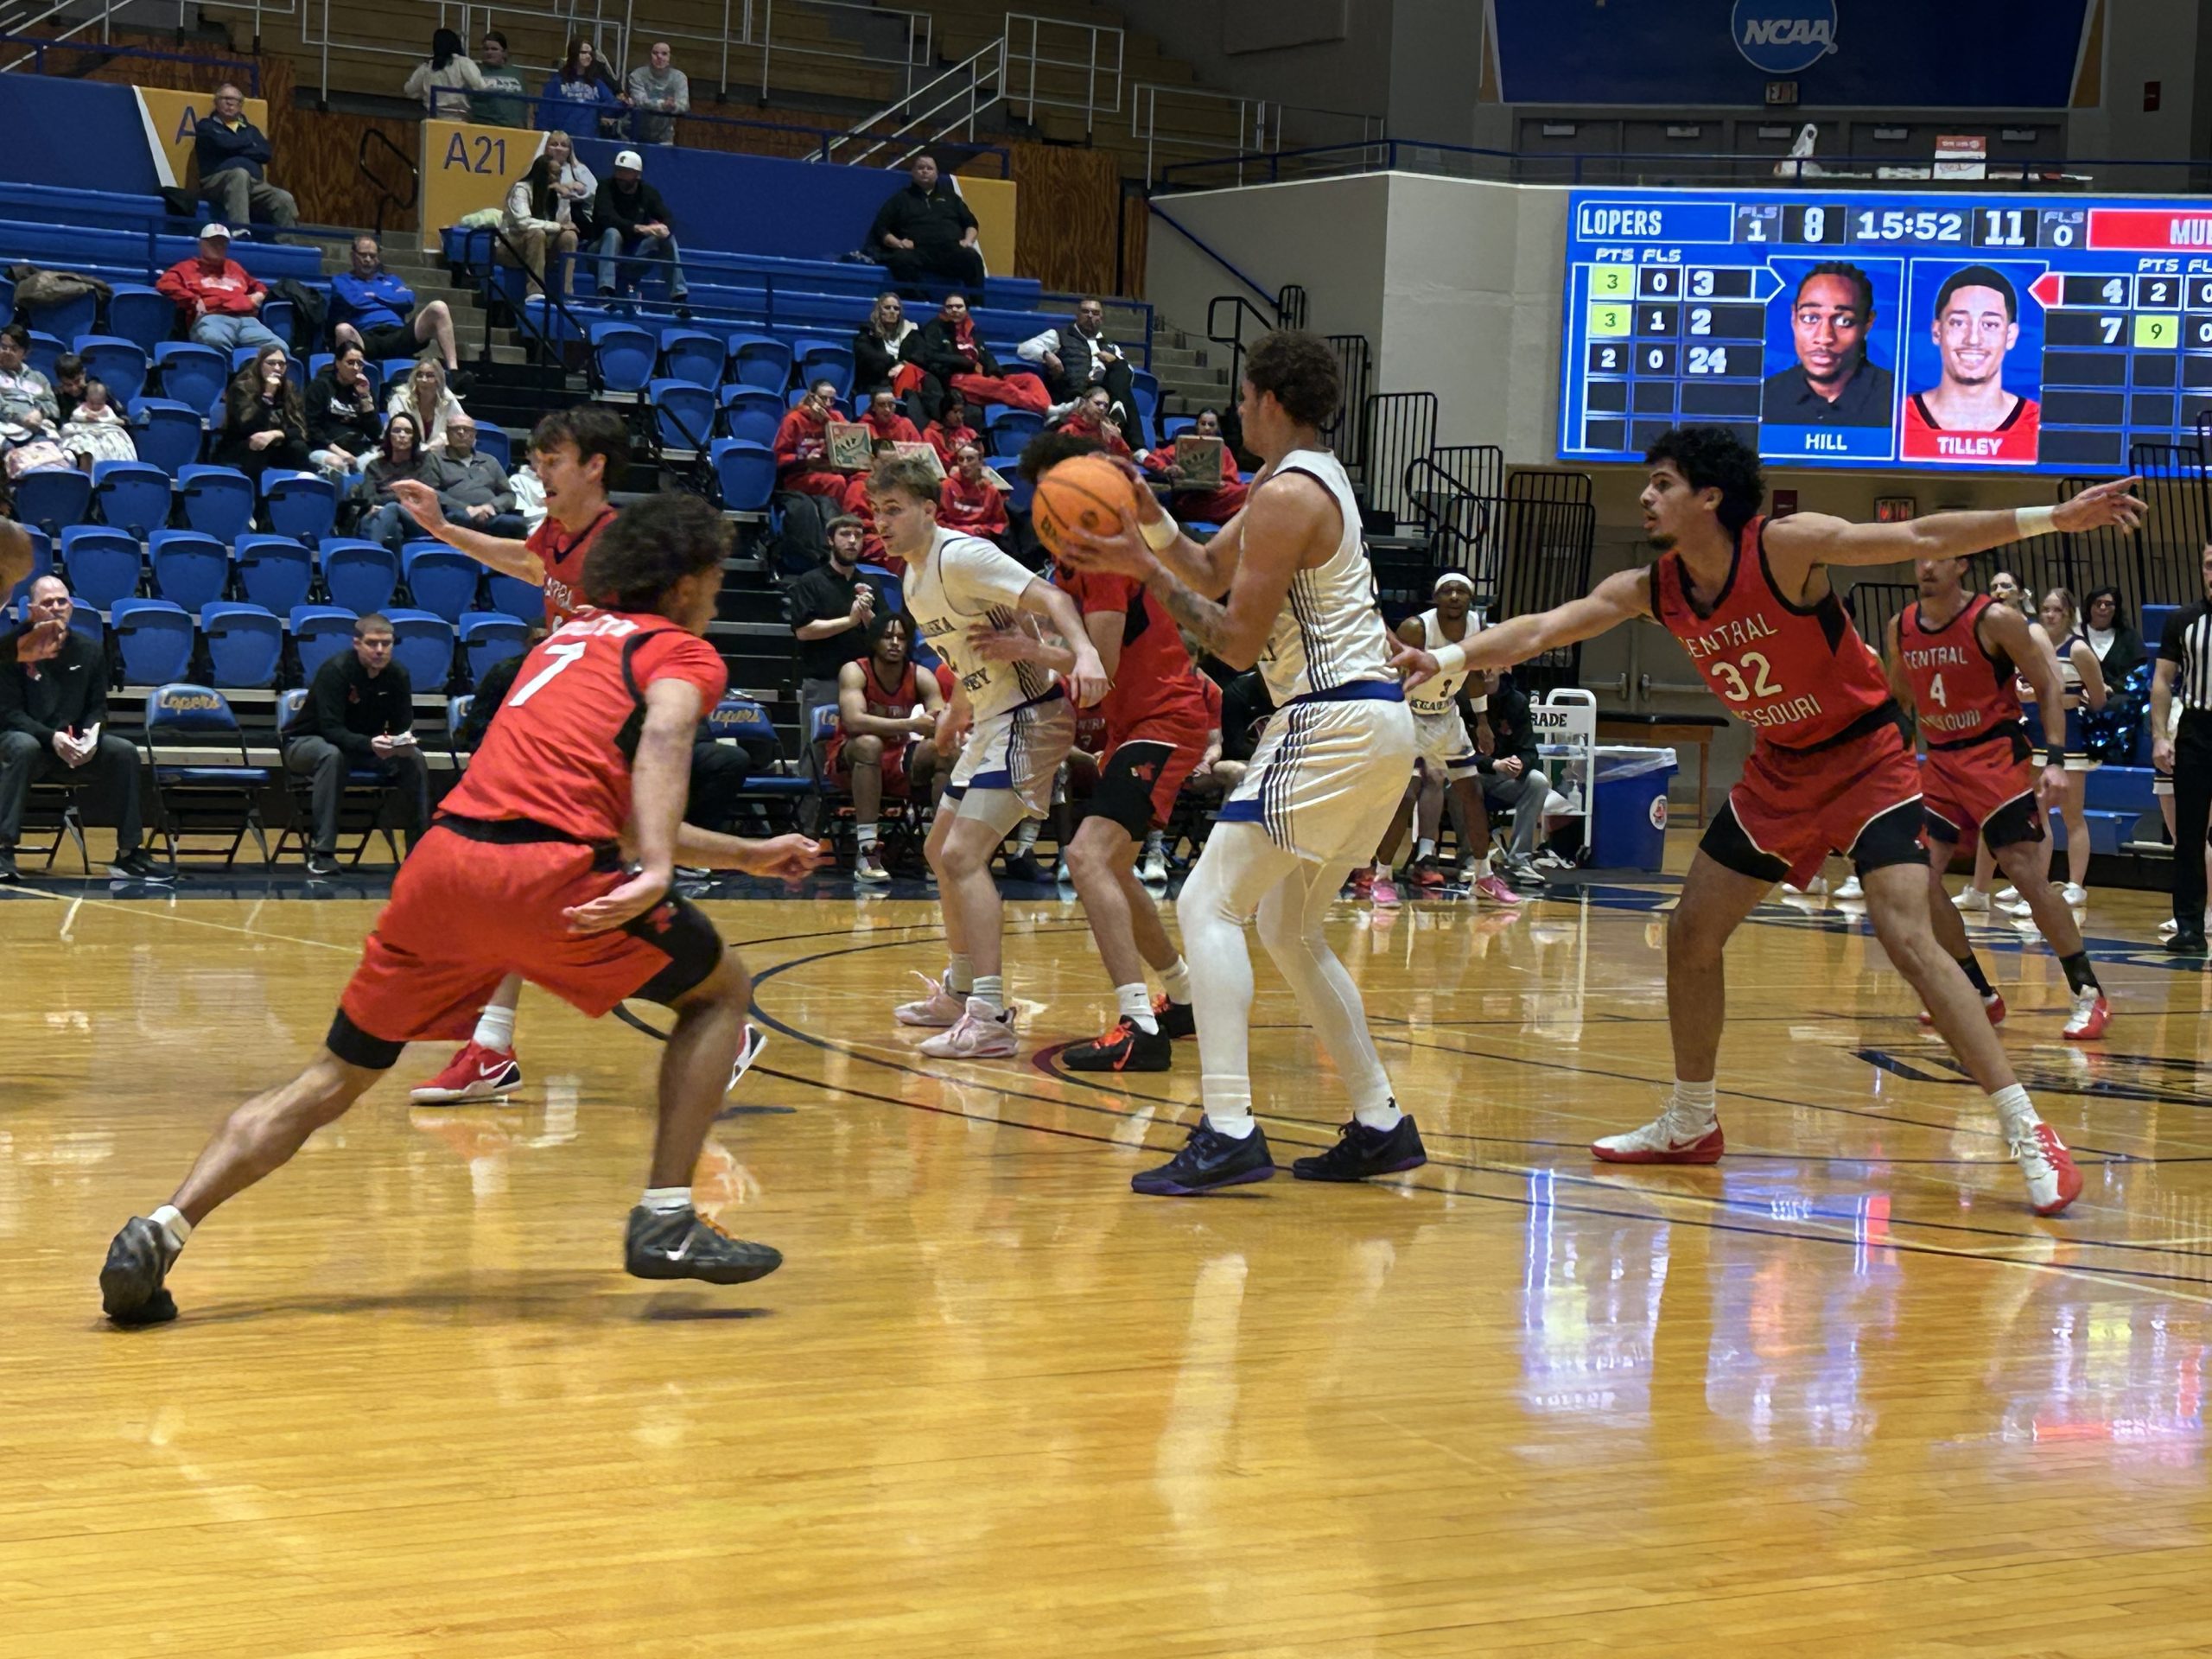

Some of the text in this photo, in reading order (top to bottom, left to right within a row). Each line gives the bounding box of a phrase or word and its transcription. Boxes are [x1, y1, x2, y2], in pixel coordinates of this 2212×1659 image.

[1743, 19, 1831, 45] NCAA
[443, 131, 505, 175] A21
[1581, 209, 1662, 235] LOPERS
[1746, 219, 1766, 242] 1
[1803, 207, 1825, 243] 8
[1857, 212, 1962, 241] 15:52
[1985, 210, 2025, 246] 11
[2053, 225, 2073, 247] 0
[1596, 247, 1682, 263] PTS FLS
[2138, 257, 2179, 272] PTS
[1606, 270, 1714, 296] 3 0 3
[2102, 278, 2124, 304] 4
[2150, 283, 2168, 302] 2
[1604, 308, 1712, 335] 3 1 2
[2100, 317, 2123, 344] 7
[2151, 323, 2163, 340] 9
[1600, 346, 1727, 374] 2 0 24
[1805, 434, 1847, 451] HILL
[1936, 436, 2004, 456] TILLEY
[507, 641, 587, 707] 7
[1711, 652, 1783, 702] 32
[1929, 673, 1947, 709] 4
[1732, 693, 1821, 728] SSOURI
